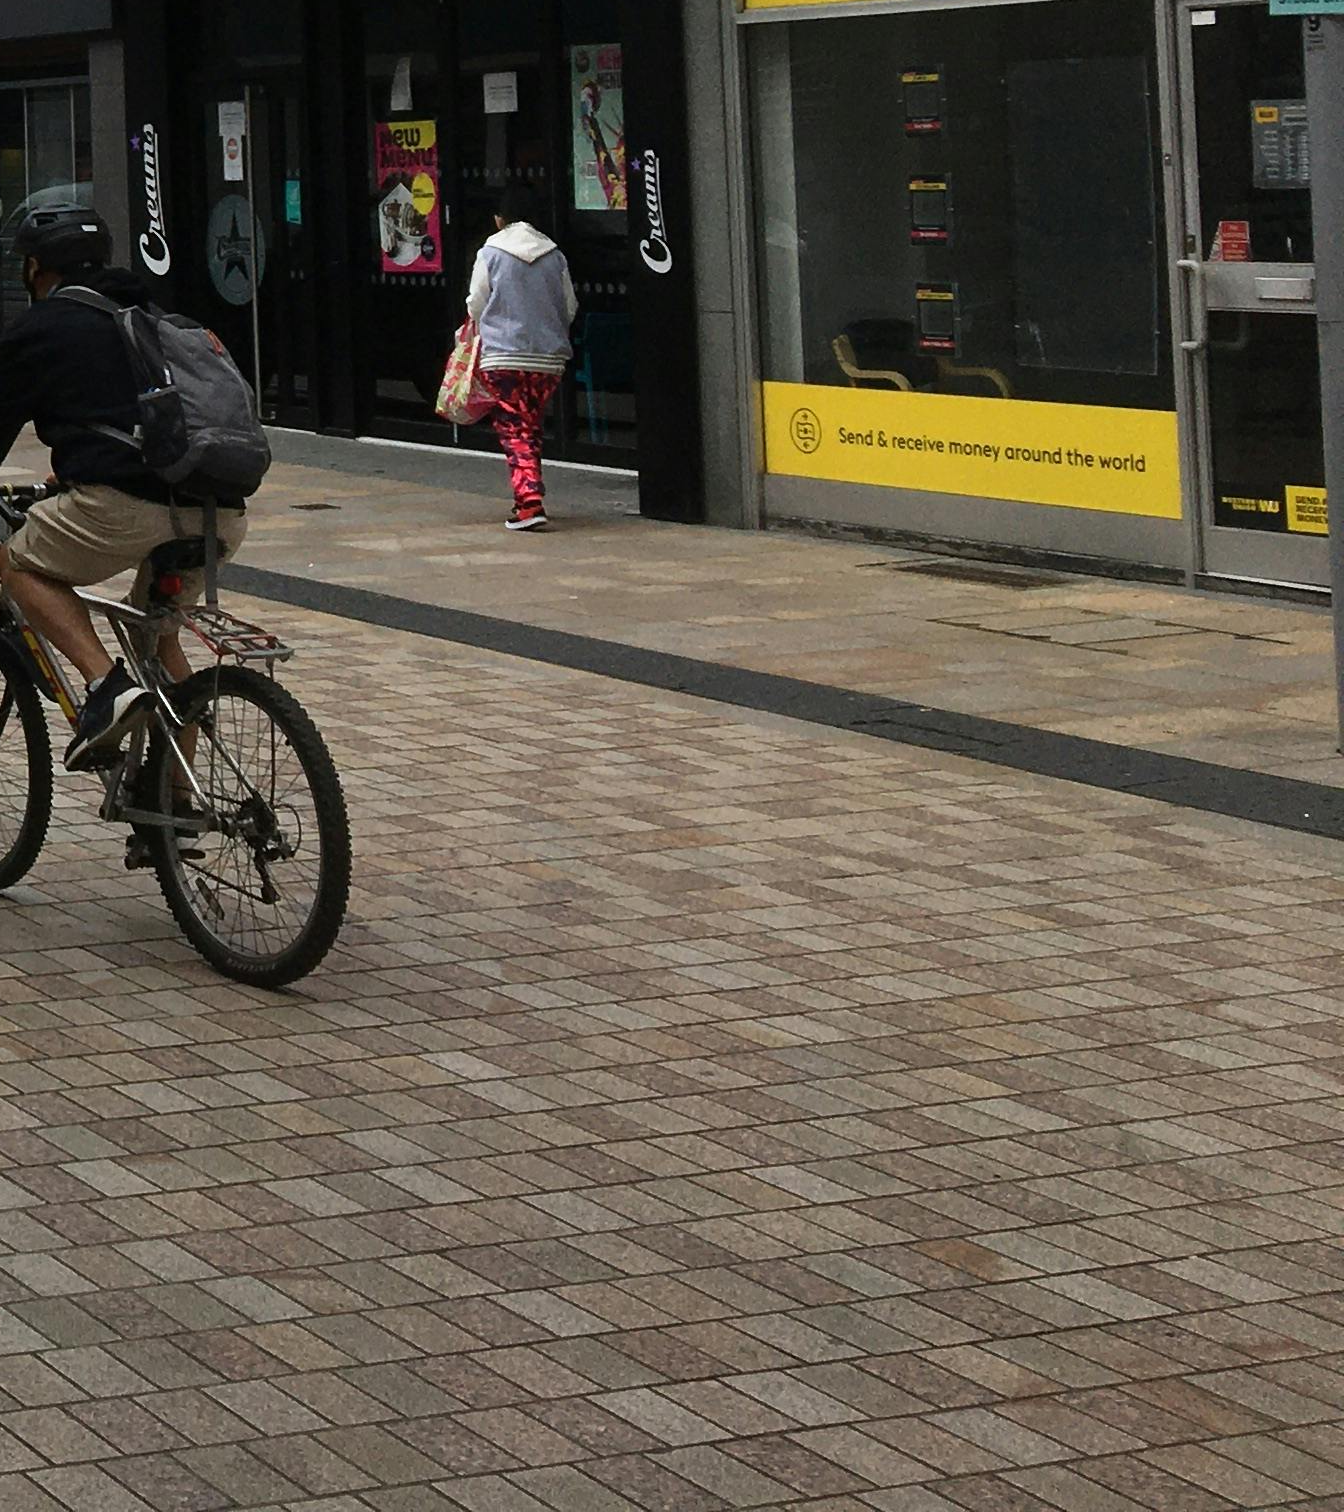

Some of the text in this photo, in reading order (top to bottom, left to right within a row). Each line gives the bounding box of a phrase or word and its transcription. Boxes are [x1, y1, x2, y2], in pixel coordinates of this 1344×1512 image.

[139, 123, 171, 276] Creams
[639, 149, 673, 274] Creams
[838, 426, 1147, 473] Send & receive money around the world
